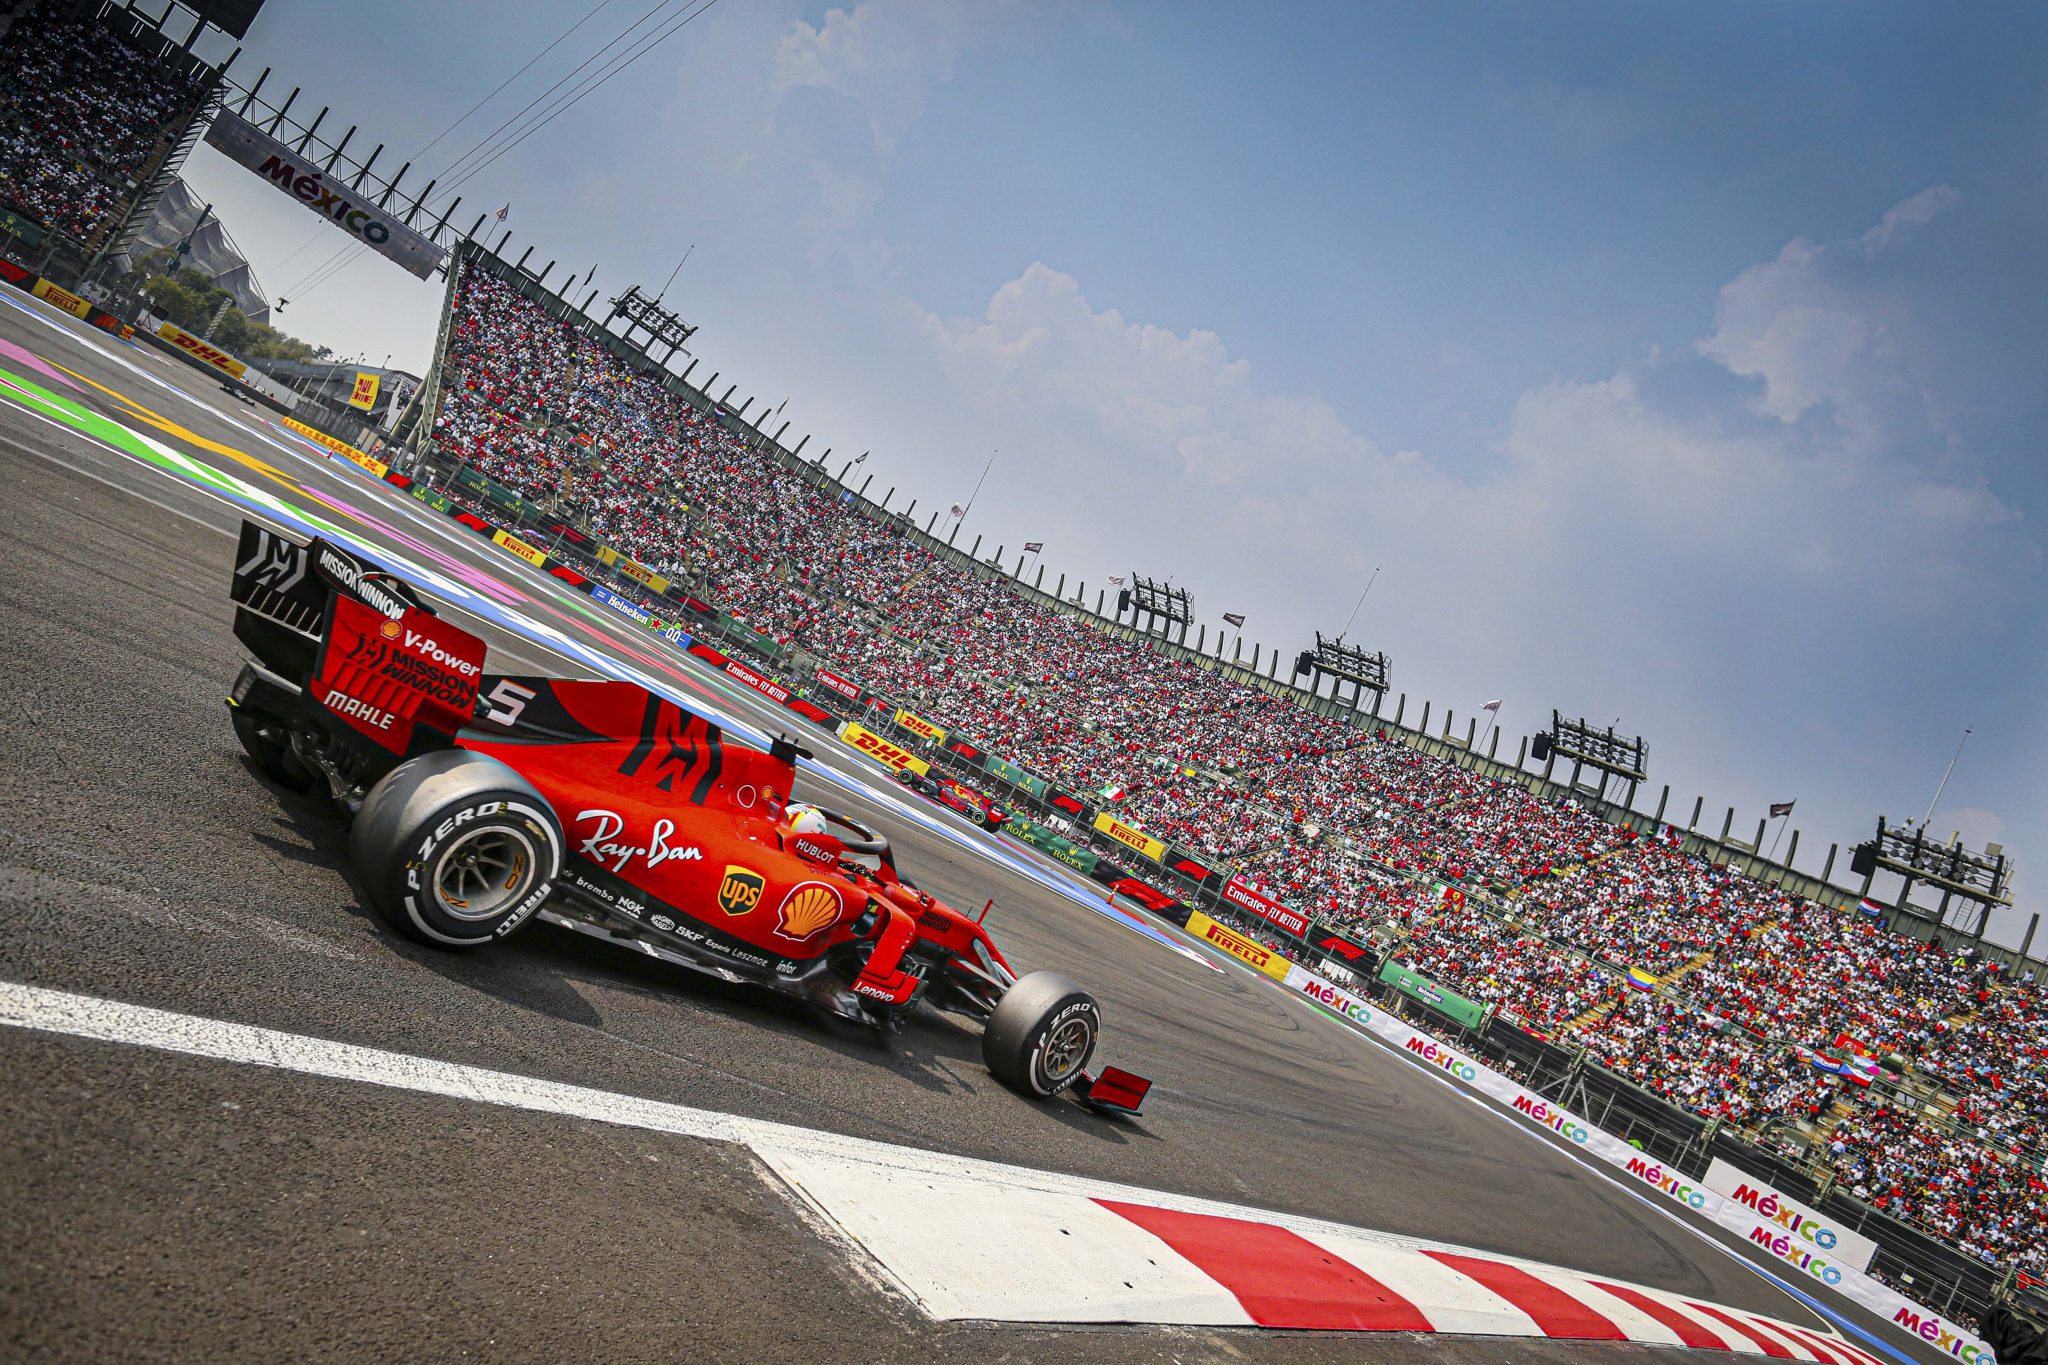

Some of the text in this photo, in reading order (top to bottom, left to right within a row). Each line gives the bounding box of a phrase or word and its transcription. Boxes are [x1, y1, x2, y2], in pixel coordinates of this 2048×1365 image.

[257, 155, 390, 244] México
[44, 286, 80, 312] PIRELLI
[173, 333, 233, 371] DHL
[503, 537, 536, 560] PIRELLI
[319, 549, 405, 620] MISSION WINNOW
[608, 595, 648, 624] Heineken
[391, 649, 476, 698] MISSION
[404, 630, 480, 677] V-Power
[381, 664, 471, 709] WINNOW
[726, 662, 759, 686] Emirates
[767, 685, 788, 702] BETTER
[323, 690, 395, 730] MAHLE
[487, 678, 538, 727] 5
[904, 715, 934, 737] DHL
[854, 732, 912, 770] DHL
[418, 802, 499, 861] ZERO
[796, 839, 835, 864] HUBLOT
[1006, 824, 1037, 844] ROLEX
[1109, 822, 1149, 850] PIRELLI
[1053, 848, 1085, 871] ROLEX
[618, 896, 645, 915] NGK
[722, 873, 758, 908] ups
[1227, 885, 1303, 932] Emirates FLY BETTER
[675, 926, 704, 942] SKF
[1205, 925, 1270, 967] PIRELLI
[776, 960, 797, 974] infor
[854, 982, 895, 1002] Lenovo
[1303, 980, 1372, 1024] México
[1050, 1003, 1091, 1030] ZERO
[1405, 1036, 1476, 1082] México
[1512, 1095, 1588, 1144] México
[1625, 1157, 1705, 1209] México
[1731, 1183, 1837, 1250] México
[1749, 1225, 1842, 1285] México
[1893, 1307, 1996, 1365] México
